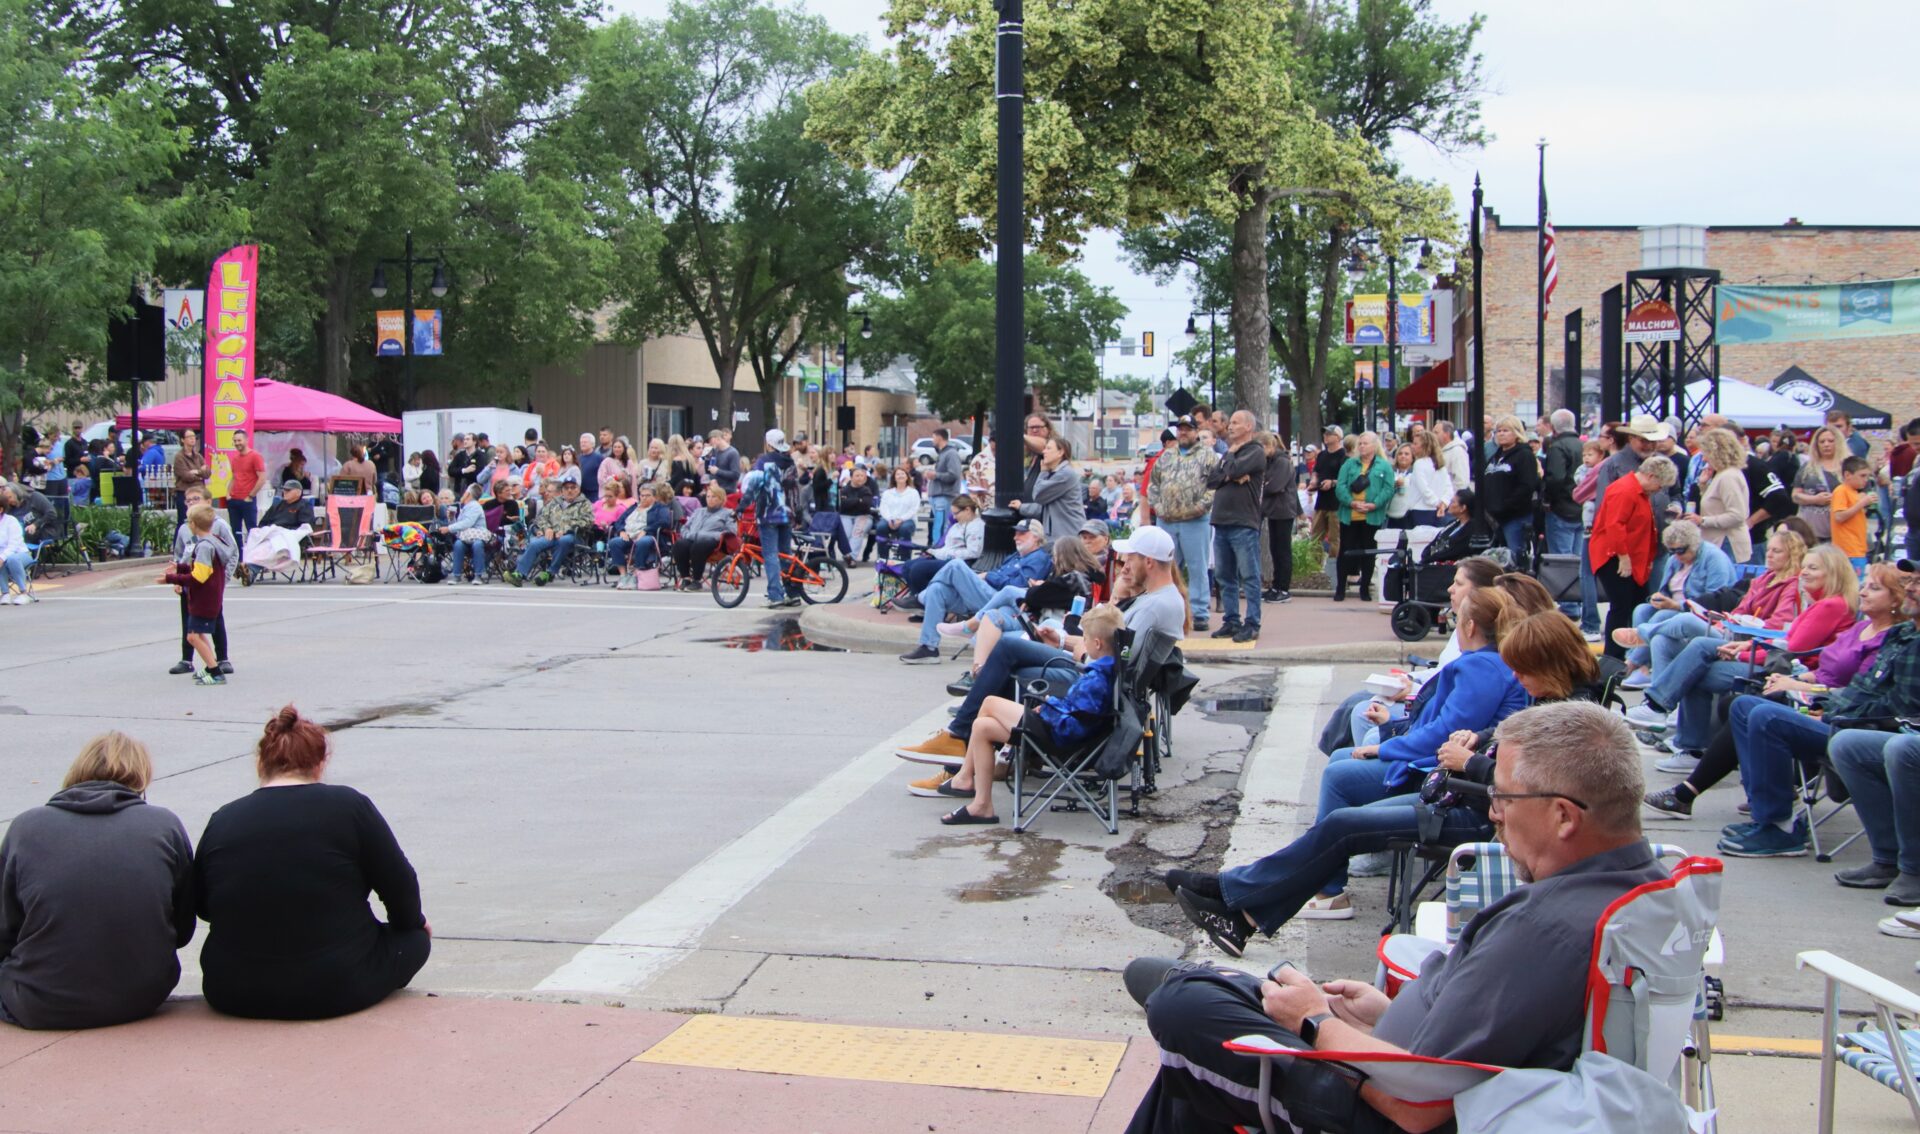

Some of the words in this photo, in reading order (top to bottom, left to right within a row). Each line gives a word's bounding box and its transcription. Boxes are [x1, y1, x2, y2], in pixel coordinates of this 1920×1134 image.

[1736, 293, 1821, 314] NIGHTS
[1628, 320, 1675, 330] MALCHOW
[213, 261, 249, 451] LEMONADE
